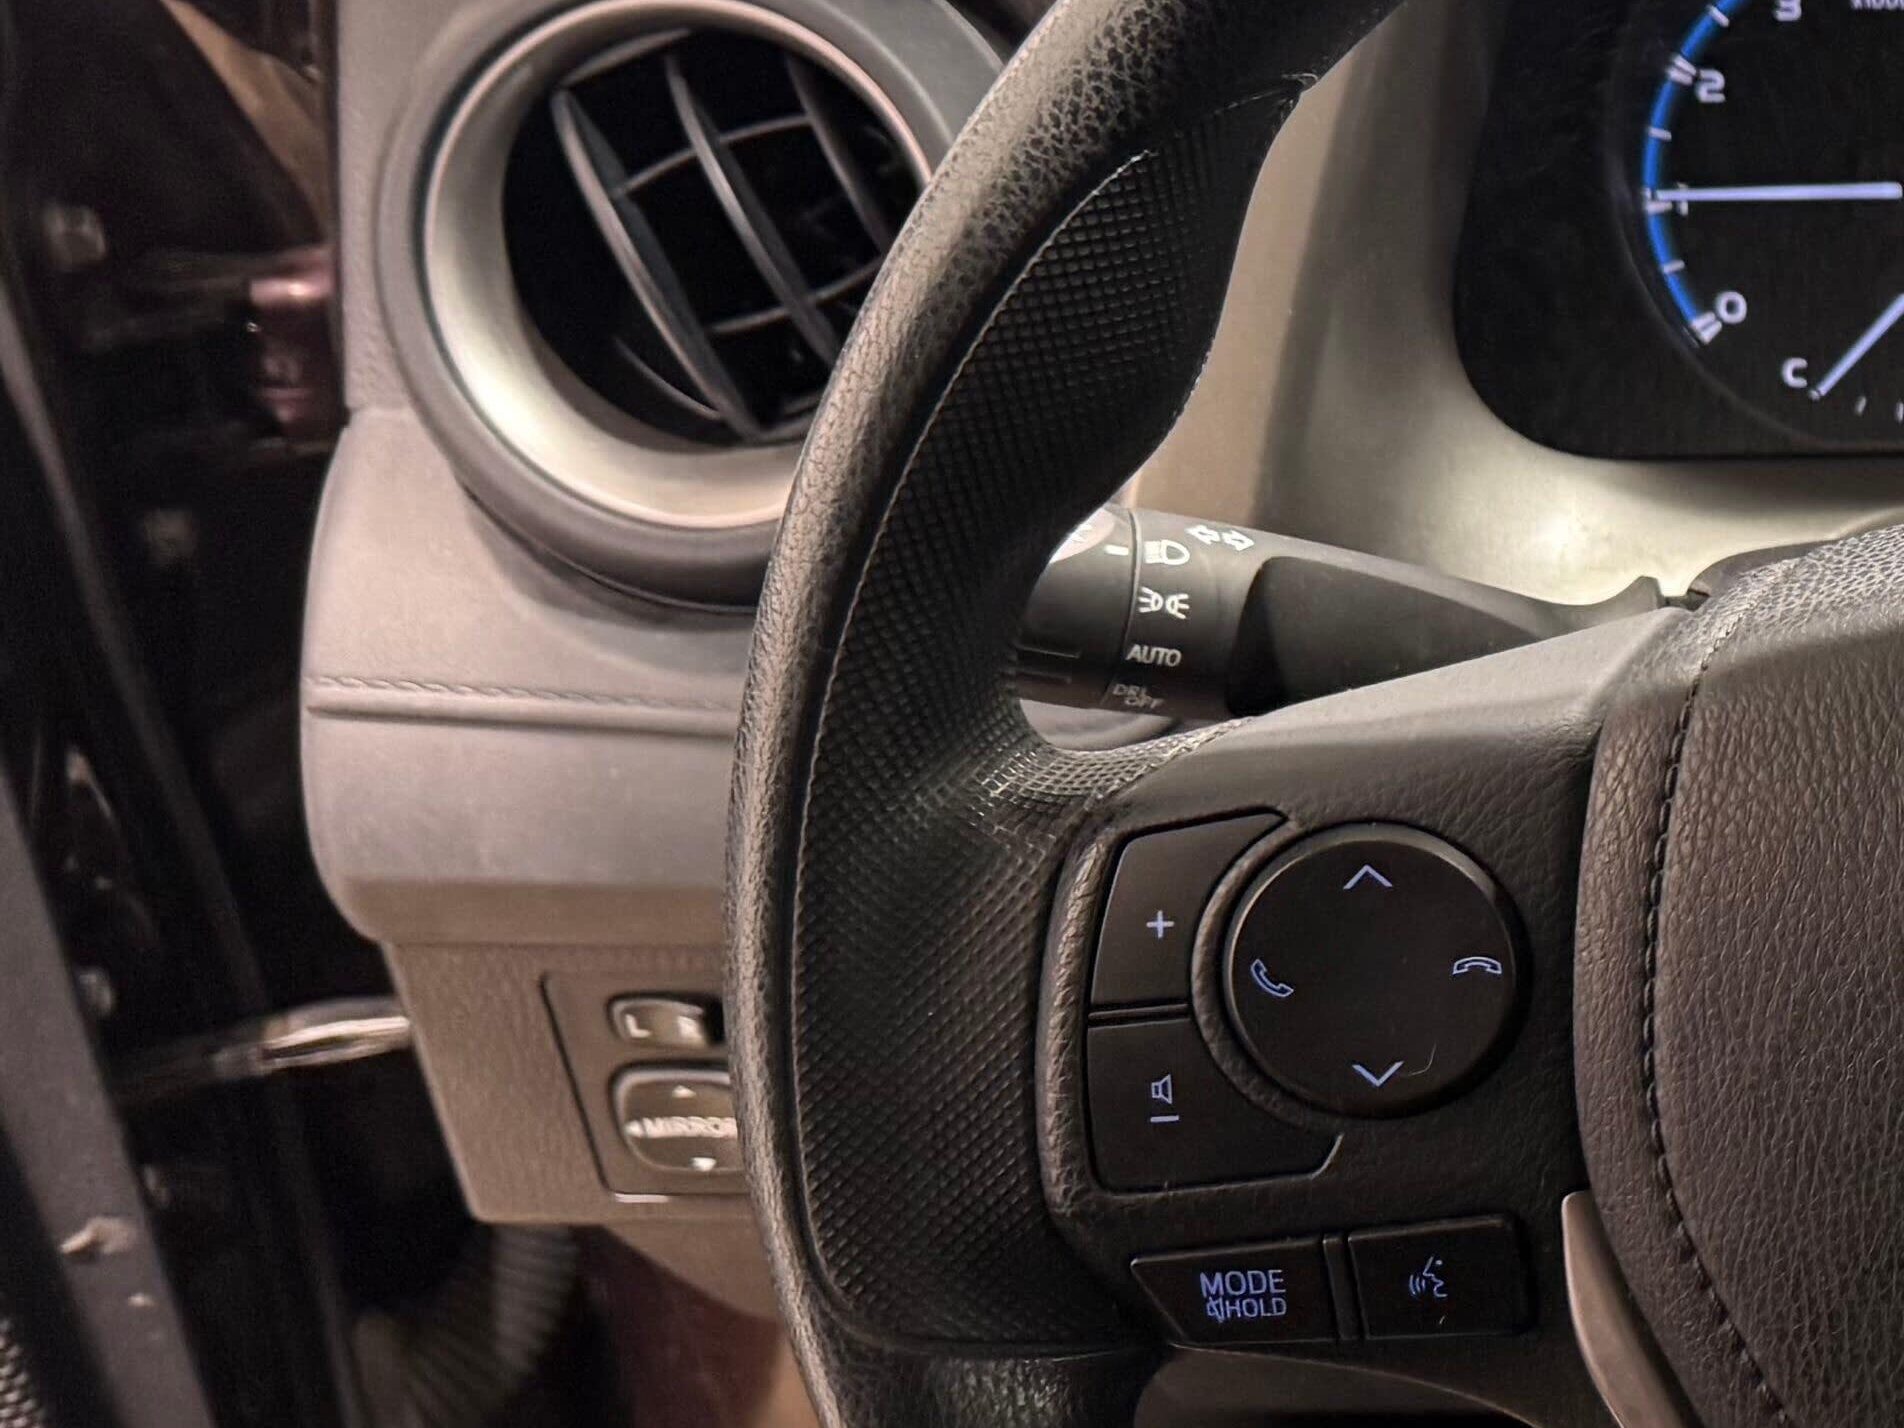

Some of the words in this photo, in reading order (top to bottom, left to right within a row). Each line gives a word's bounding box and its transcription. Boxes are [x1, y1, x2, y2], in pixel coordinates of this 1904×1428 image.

[1696, 70, 1726, 103] 2
[1716, 293, 1748, 324] 0
[1783, 359, 1807, 387] C
[1126, 644, 1182, 667] AUTO
[1200, 1269, 1286, 1298] MODE
[1226, 1298, 1287, 1318] HOLD
